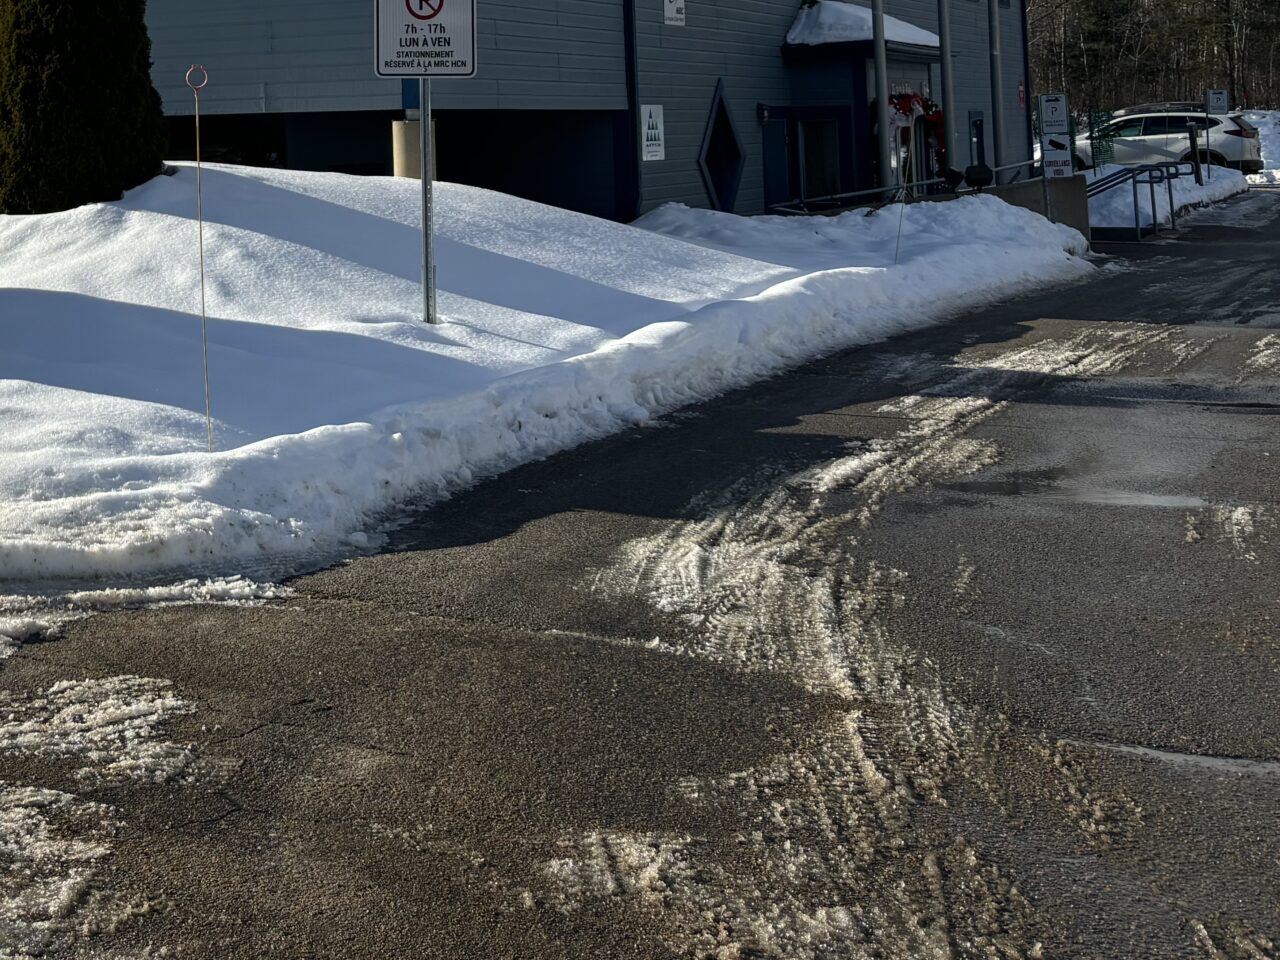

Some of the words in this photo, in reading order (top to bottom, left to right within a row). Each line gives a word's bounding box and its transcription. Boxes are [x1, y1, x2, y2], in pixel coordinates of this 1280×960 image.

[404, 23, 417, 34] 7h
[428, 23, 446, 34] 17h
[399, 37, 419, 47] LUN
[422, 35, 429, 47] À
[431, 37, 451, 47] VEN
[384, 59, 415, 68] RÉSERVÉ
[417, 59, 422, 68] À
[423, 60, 432, 68] LA
[434, 60, 449, 68] MRC
[451, 60, 467, 68] HCN
